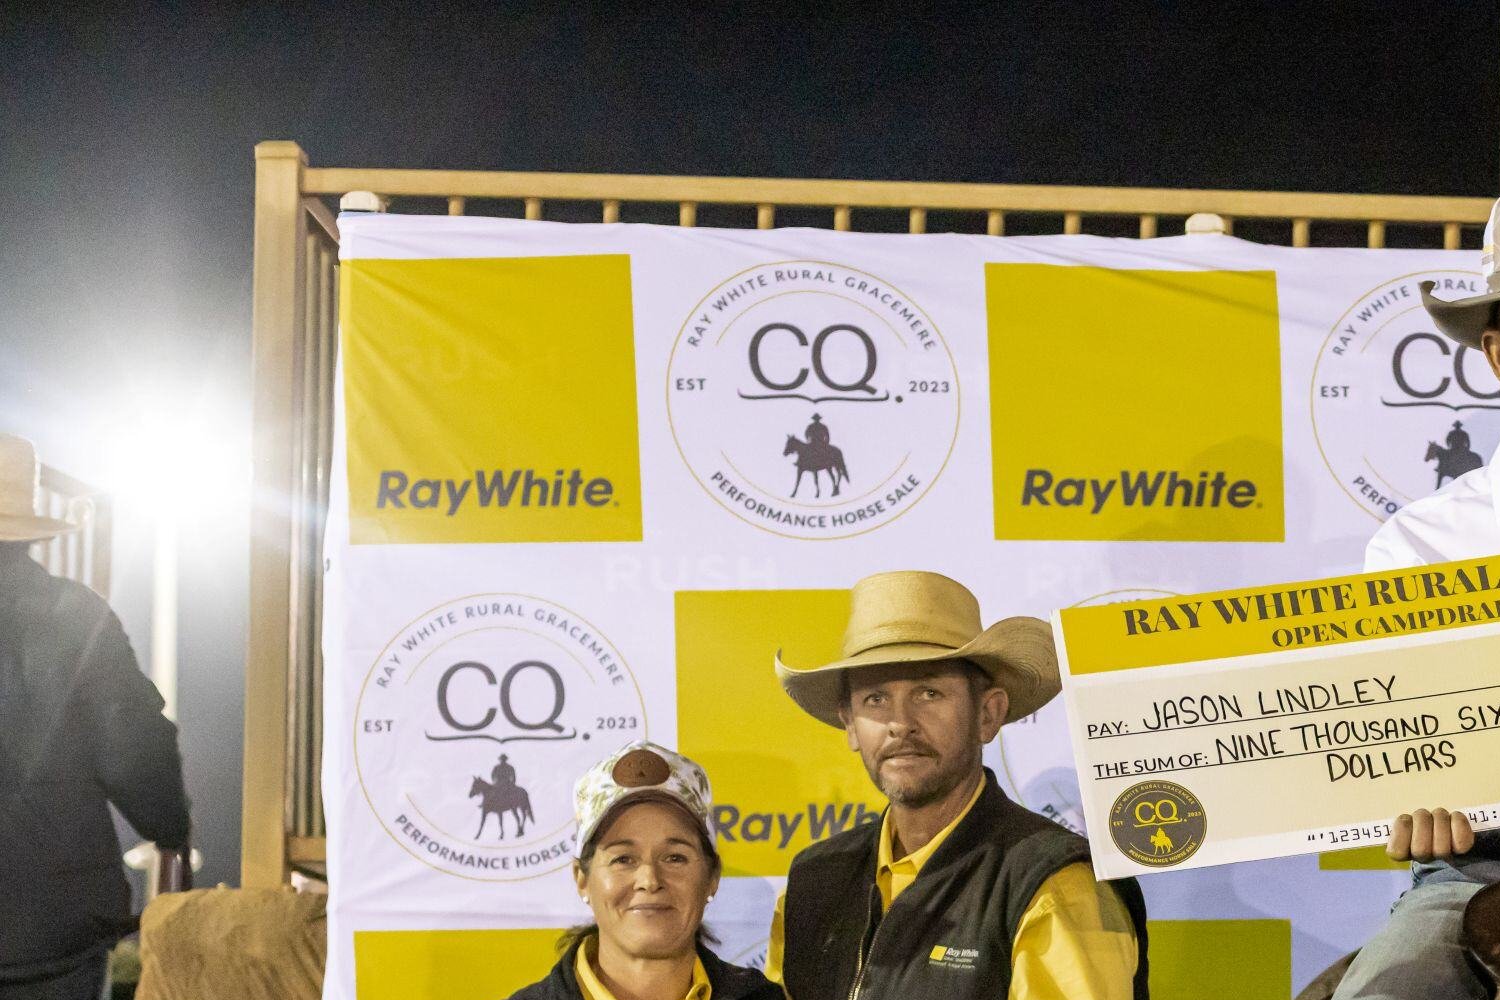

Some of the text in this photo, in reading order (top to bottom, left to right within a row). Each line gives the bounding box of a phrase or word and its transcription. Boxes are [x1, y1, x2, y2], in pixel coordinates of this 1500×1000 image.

[687, 269, 937, 351] RAY WHITE RURAL GRACEMERE
[1331, 323, 1359, 356] RAY
[1356, 285, 1411, 324] WHITE
[676, 377, 950, 393] EST 2023
[1320, 385, 1350, 398] EST
[710, 470, 921, 528] PERFORMANCE HORSE SALE
[1122, 601, 1203, 637] RAY
[1211, 583, 1358, 625] WHITE
[1271, 621, 1349, 648] OPEN
[376, 602, 625, 688] RAY WHITE RURAL GRACEMERE
[363, 717, 638, 732] EST 2023
[1087, 674, 1398, 738] PAY: JASON LINDLEY
[1093, 760, 1131, 779] THE
[1134, 755, 1175, 773] SUM
[1177, 752, 1209, 770] OF:
[1215, 729, 1285, 765] NINE
[1289, 713, 1441, 751] THOUSAND
[1326, 740, 1457, 782] DOLLARS
[394, 813, 570, 870] PERFORMANCE HORSE
